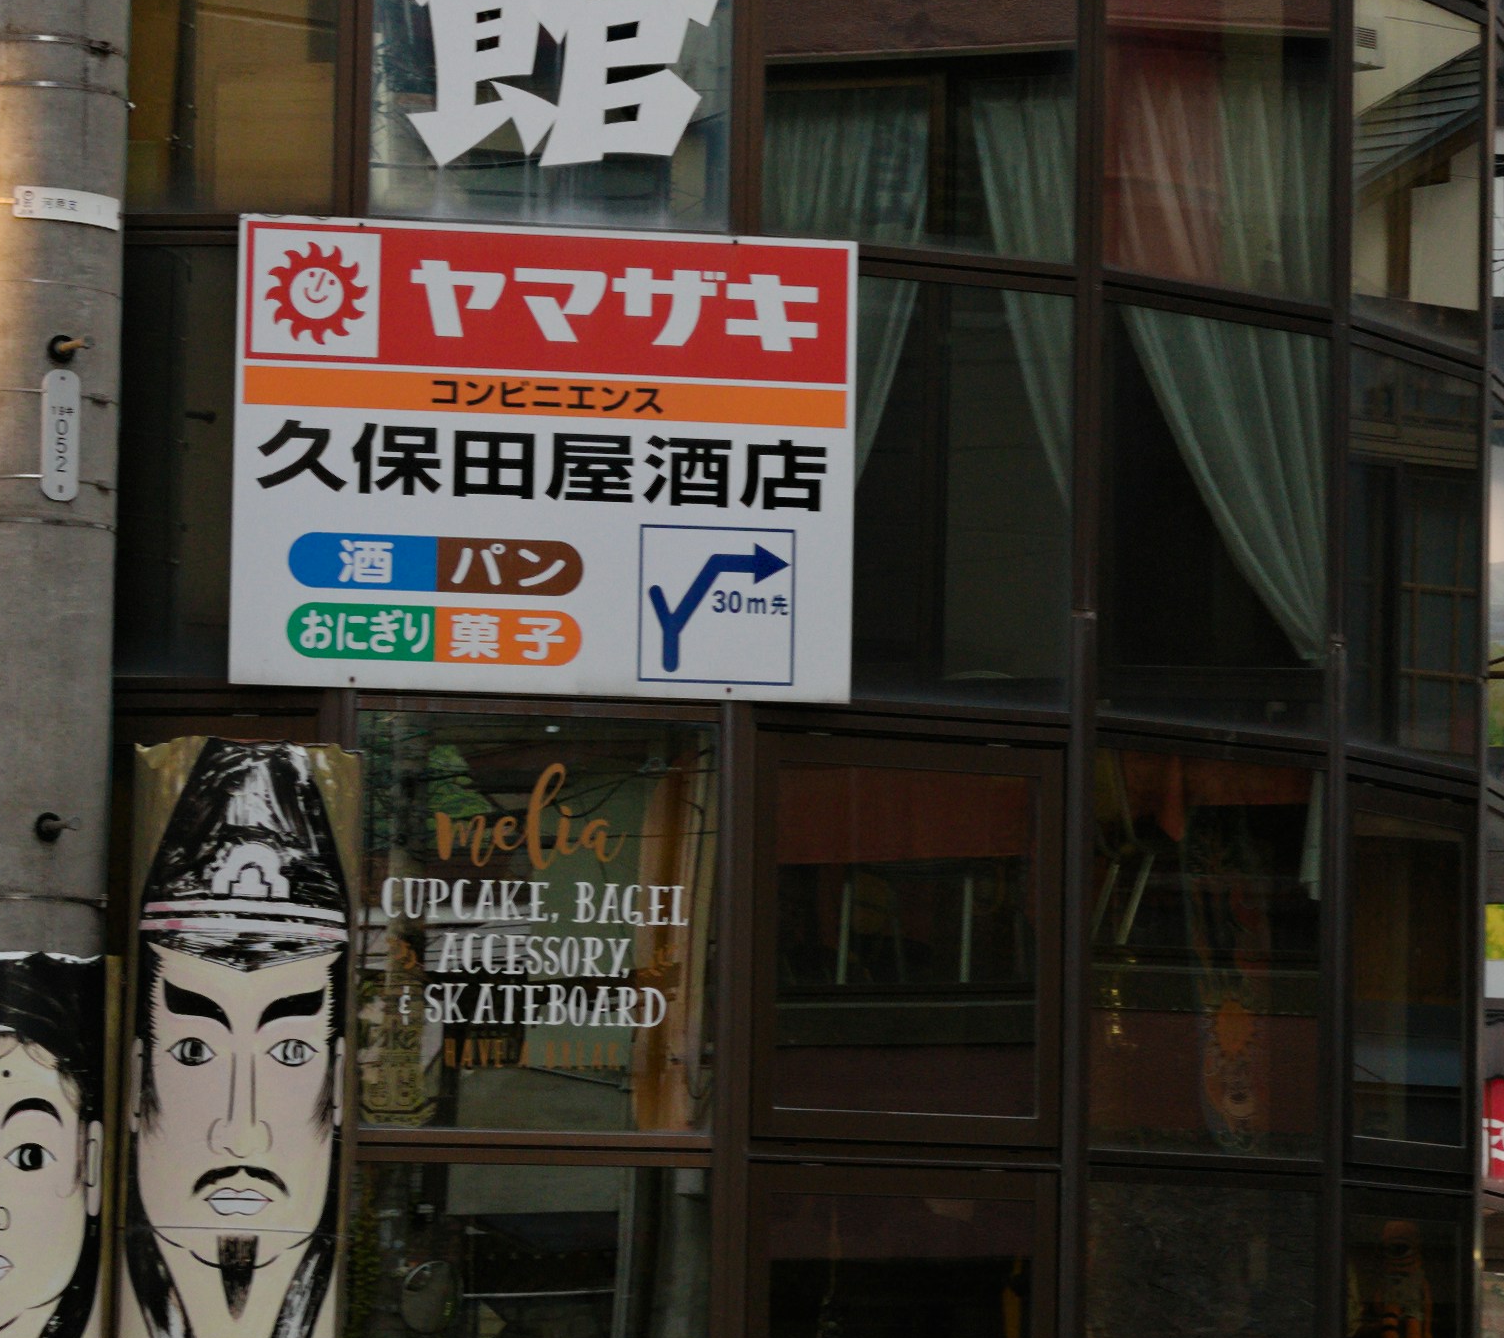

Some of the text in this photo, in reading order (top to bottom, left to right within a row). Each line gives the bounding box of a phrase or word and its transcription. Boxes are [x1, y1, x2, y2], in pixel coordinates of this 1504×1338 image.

[410, 259, 819, 351] ヤマザキ
[431, 378, 664, 414] コンビニエンス
[256, 419, 828, 512] 久保田屋酒店
[338, 539, 566, 588] 酒 パン
[299, 609, 566, 660] おにぎり 菓子
[435, 762, 626, 870] melia
[381, 877, 689, 927] CUPCAKE, BAGEL
[436, 932, 631, 979] ACCESSORY,
[424, 983, 667, 1028] SKATEBOARD
[444, 1038, 504, 1068] HAVE
[519, 1040, 530, 1069] A
